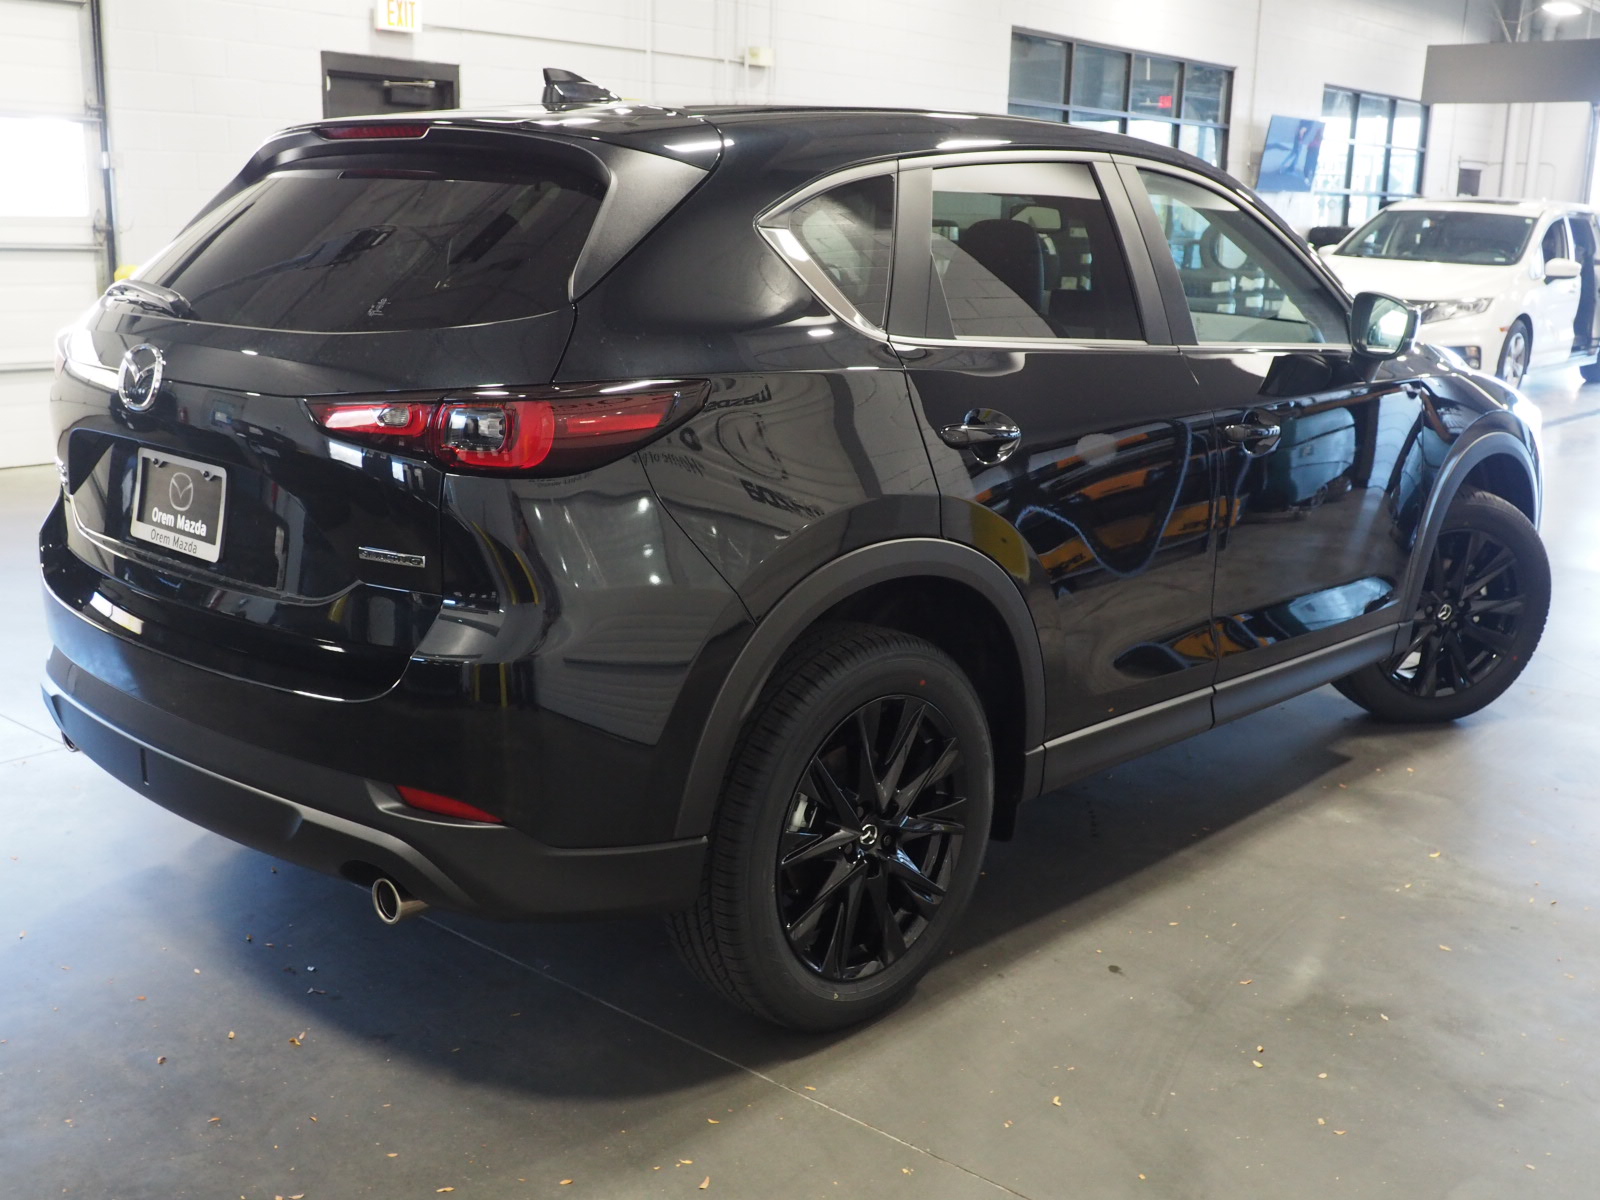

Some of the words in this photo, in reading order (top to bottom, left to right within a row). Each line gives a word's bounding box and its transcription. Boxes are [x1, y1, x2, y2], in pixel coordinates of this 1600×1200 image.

[387, 0, 416, 28] EXIT
[152, 507, 175, 528] Orem
[177, 513, 207, 537] Mazda
[151, 528, 171, 545] Orem
[172, 535, 198, 554] Mazda
